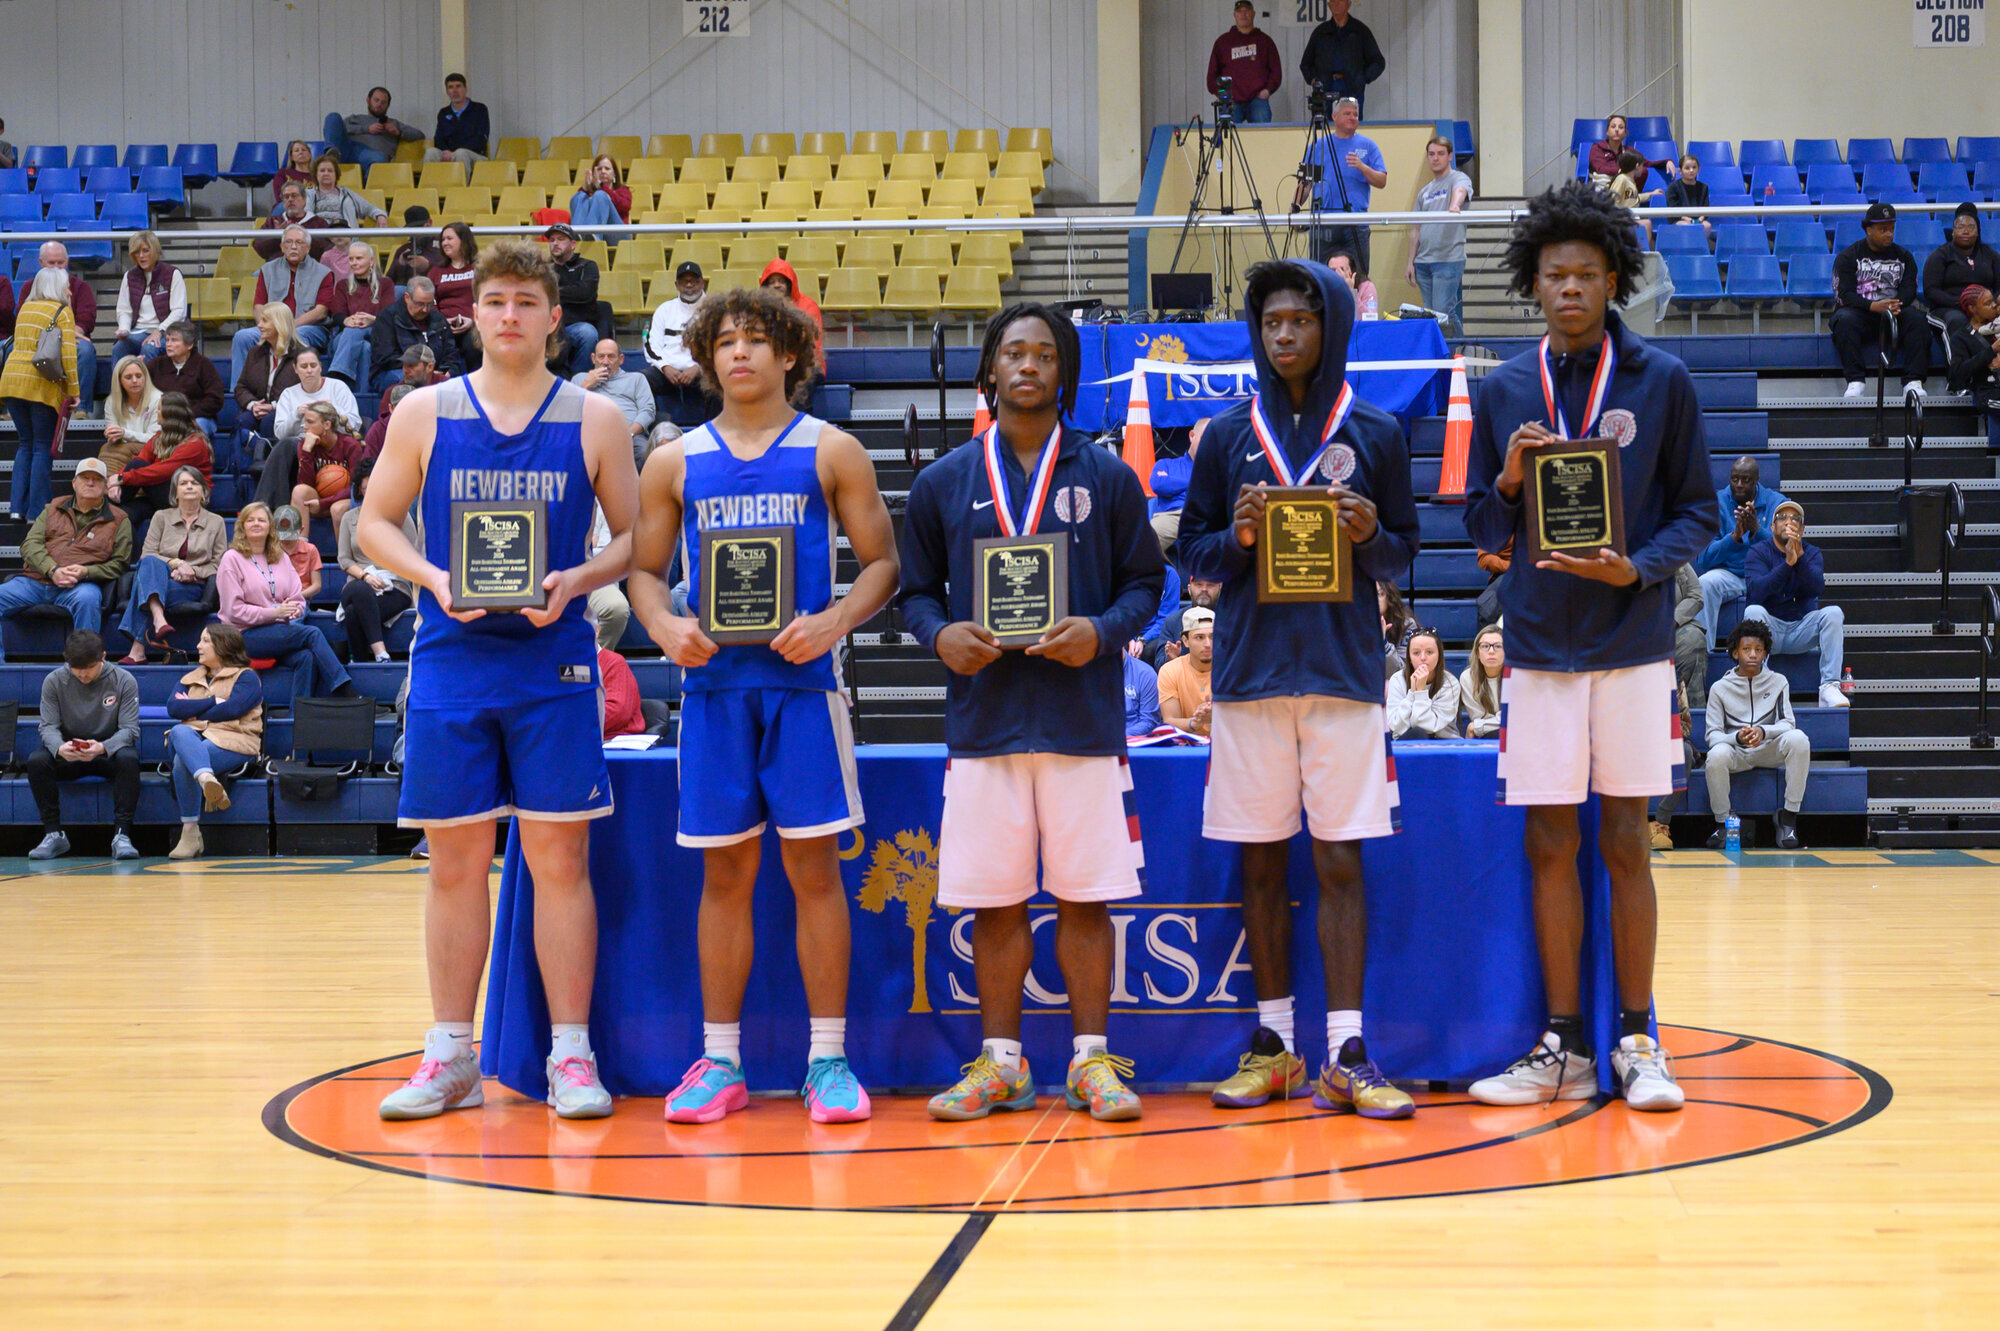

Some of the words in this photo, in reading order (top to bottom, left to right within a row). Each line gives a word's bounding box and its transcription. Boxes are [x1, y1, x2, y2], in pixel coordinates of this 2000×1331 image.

[699, 6, 729, 32] 212
[1297, 0, 1328, 22] 210
[1932, 14, 1970, 42] 208
[1562, 464, 1592, 475] SCISA
[450, 468, 568, 502] NEWBERRY
[694, 493, 809, 530] NEWBERRY
[1292, 511, 1322, 522] SCISA
[489, 522, 520, 530] SCISA
[737, 550, 767, 560] SCISA
[1009, 556, 1039, 566] SCISA
